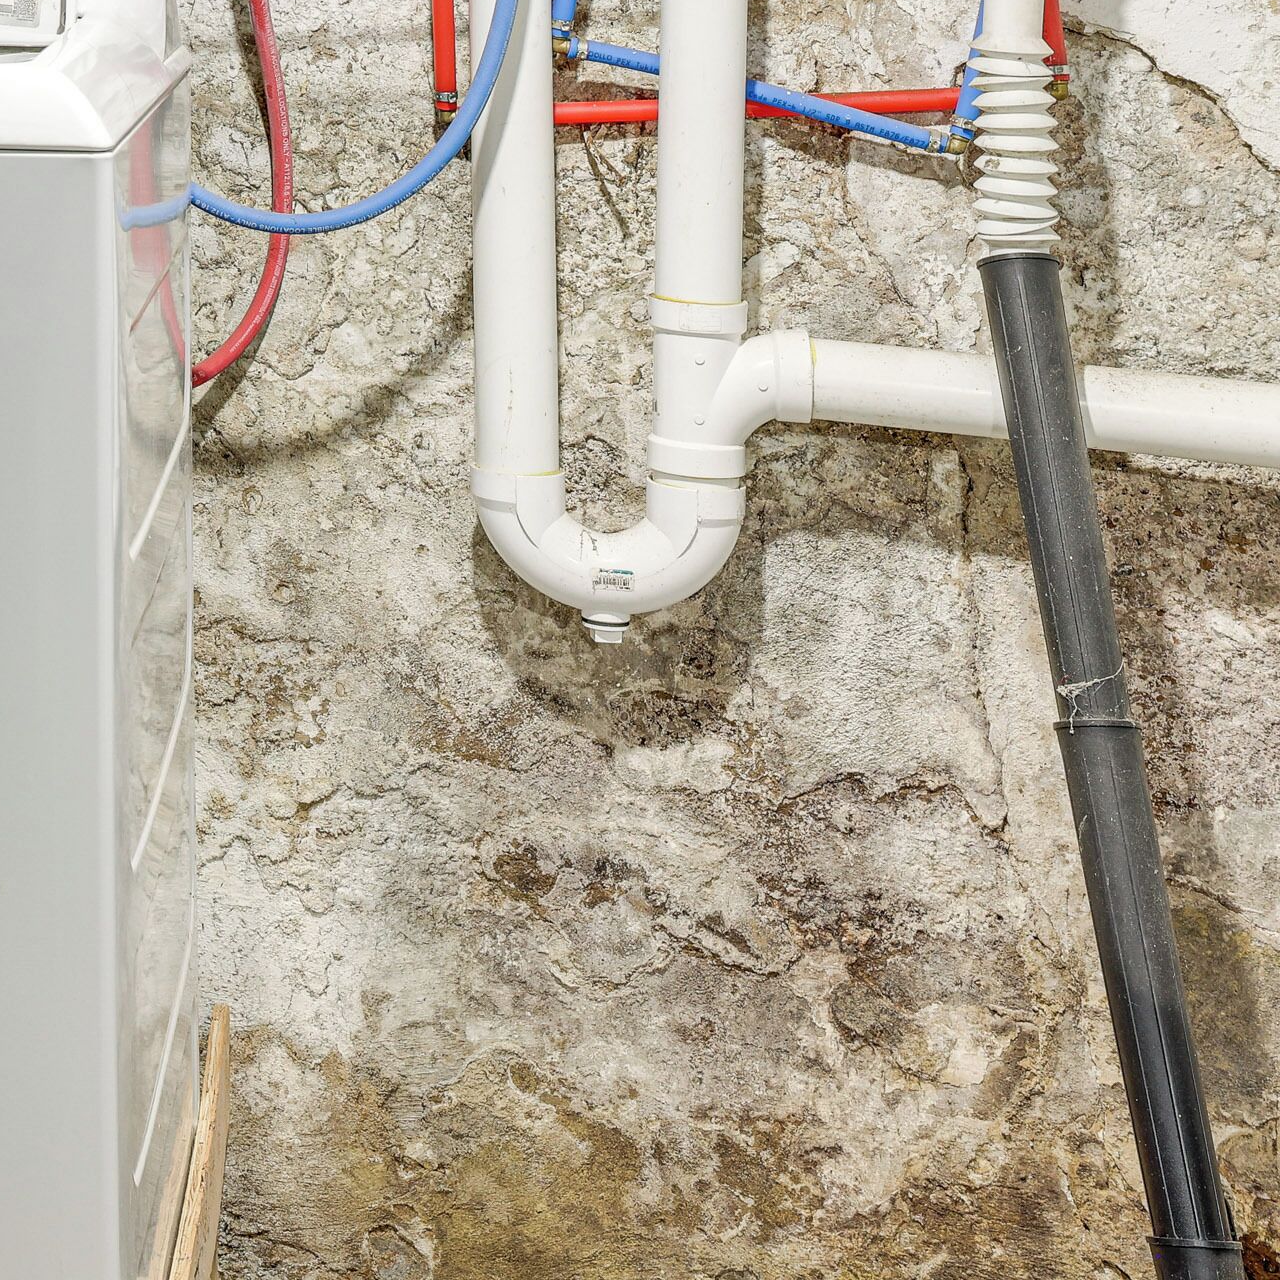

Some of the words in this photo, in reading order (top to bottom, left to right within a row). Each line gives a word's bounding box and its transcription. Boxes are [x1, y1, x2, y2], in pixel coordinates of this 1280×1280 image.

[616, 57, 632, 66] PEX
[278, 97, 289, 137] LOCATIONS
[853, 121, 876, 133] ASTM
[282, 138, 290, 157] ONLY
[238, 219, 258, 230] ONLY
[259, 224, 306, 234] LOCATIONS
